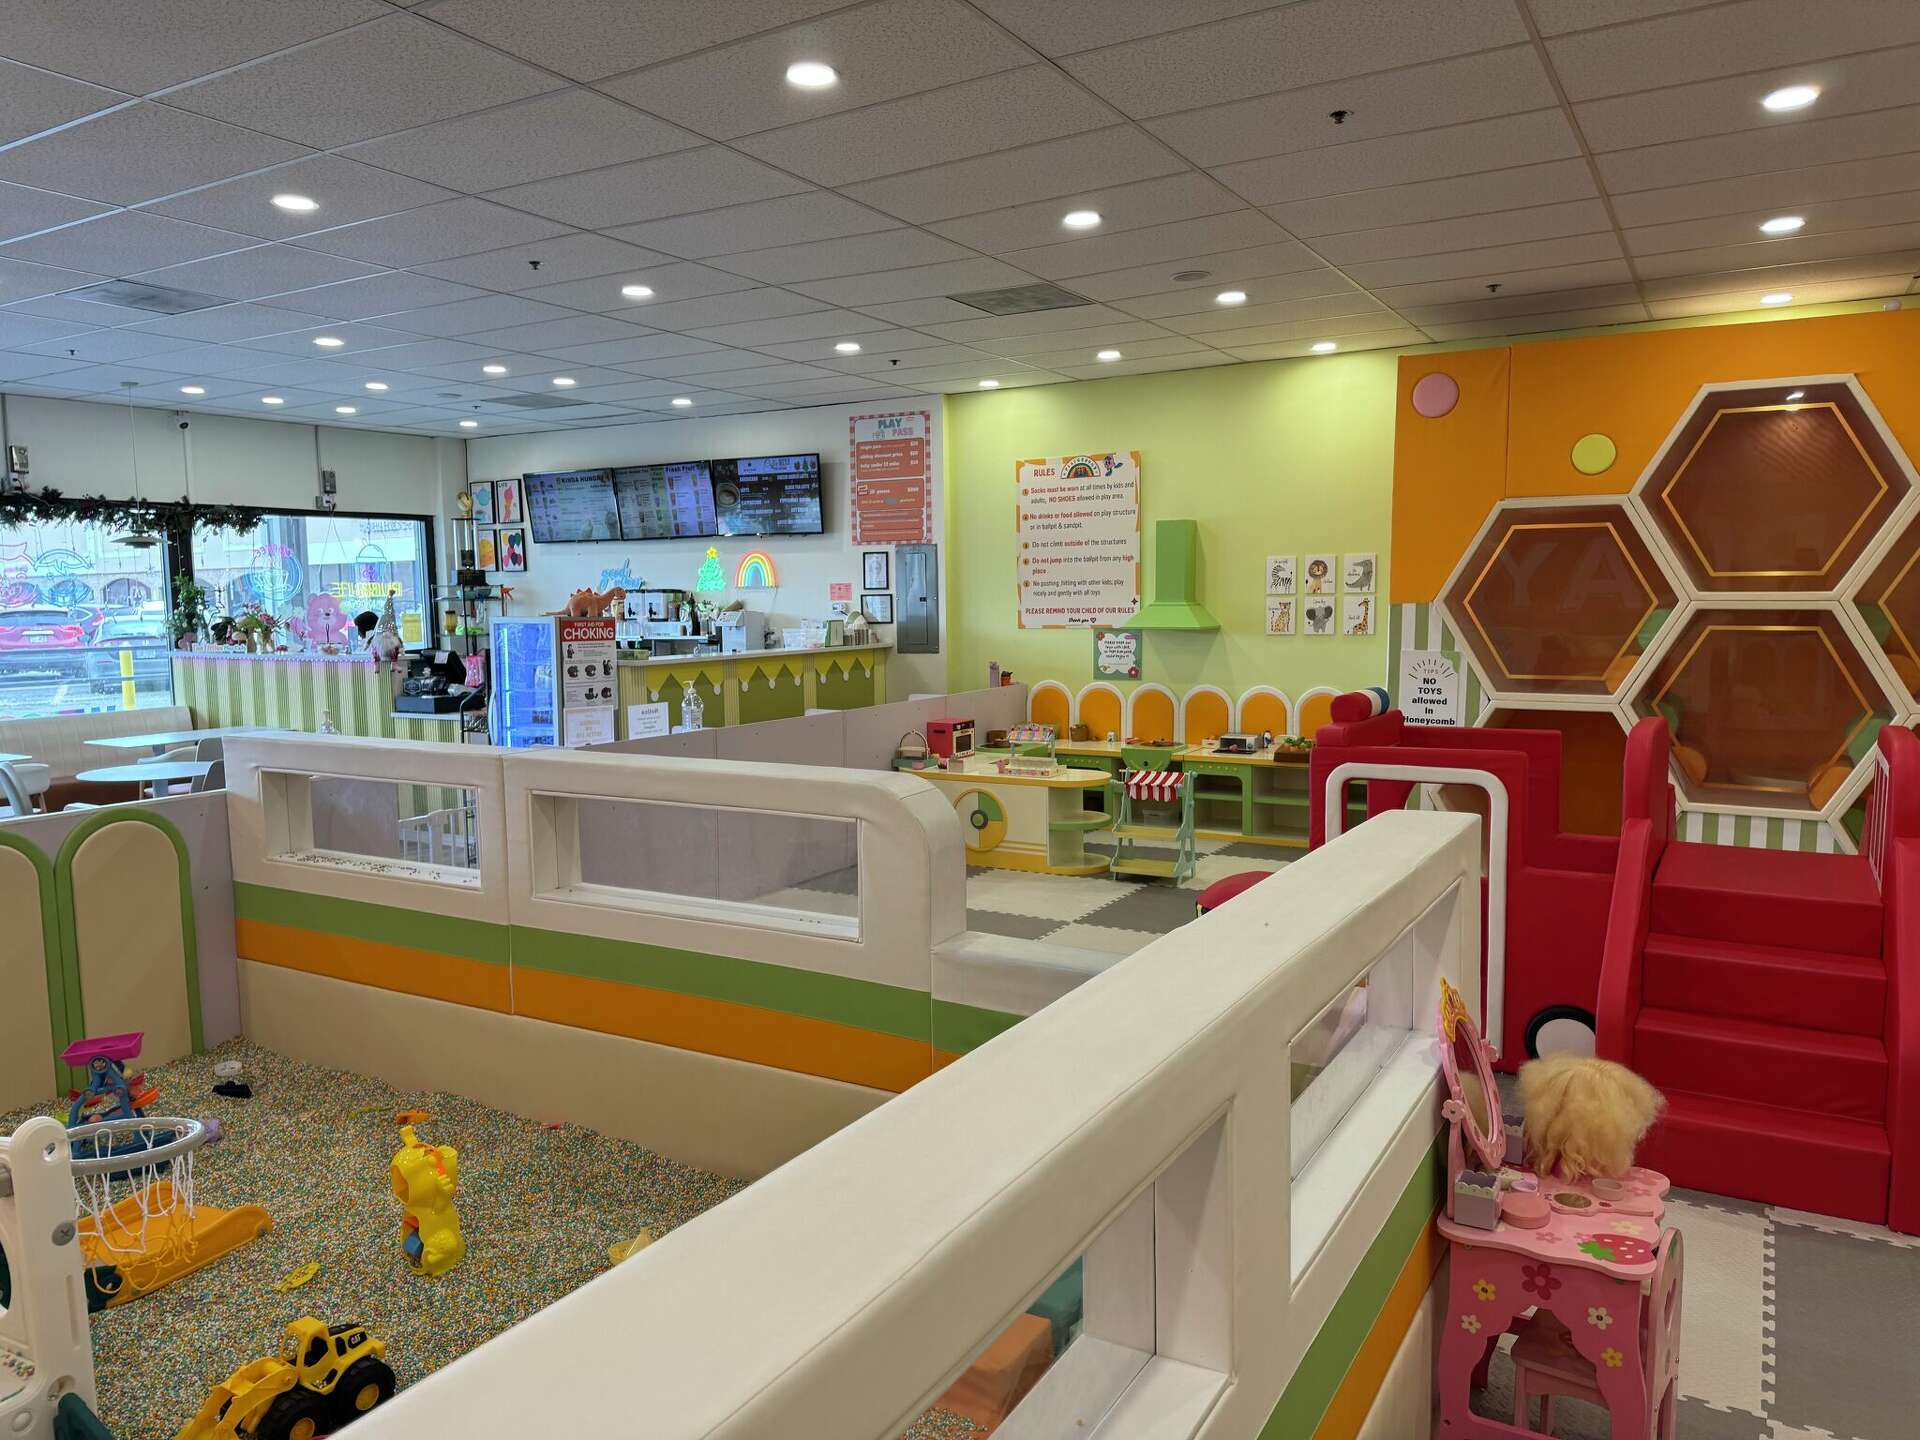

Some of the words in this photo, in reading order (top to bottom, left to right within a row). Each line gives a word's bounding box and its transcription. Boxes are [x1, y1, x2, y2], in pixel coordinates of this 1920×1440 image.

[878, 418, 902, 429] PLAY
[893, 428, 913, 436] PASS
[1033, 468, 1055, 477] RULES
[564, 627, 614, 640] CHOKING
[351, 1334, 360, 1344] CAT
